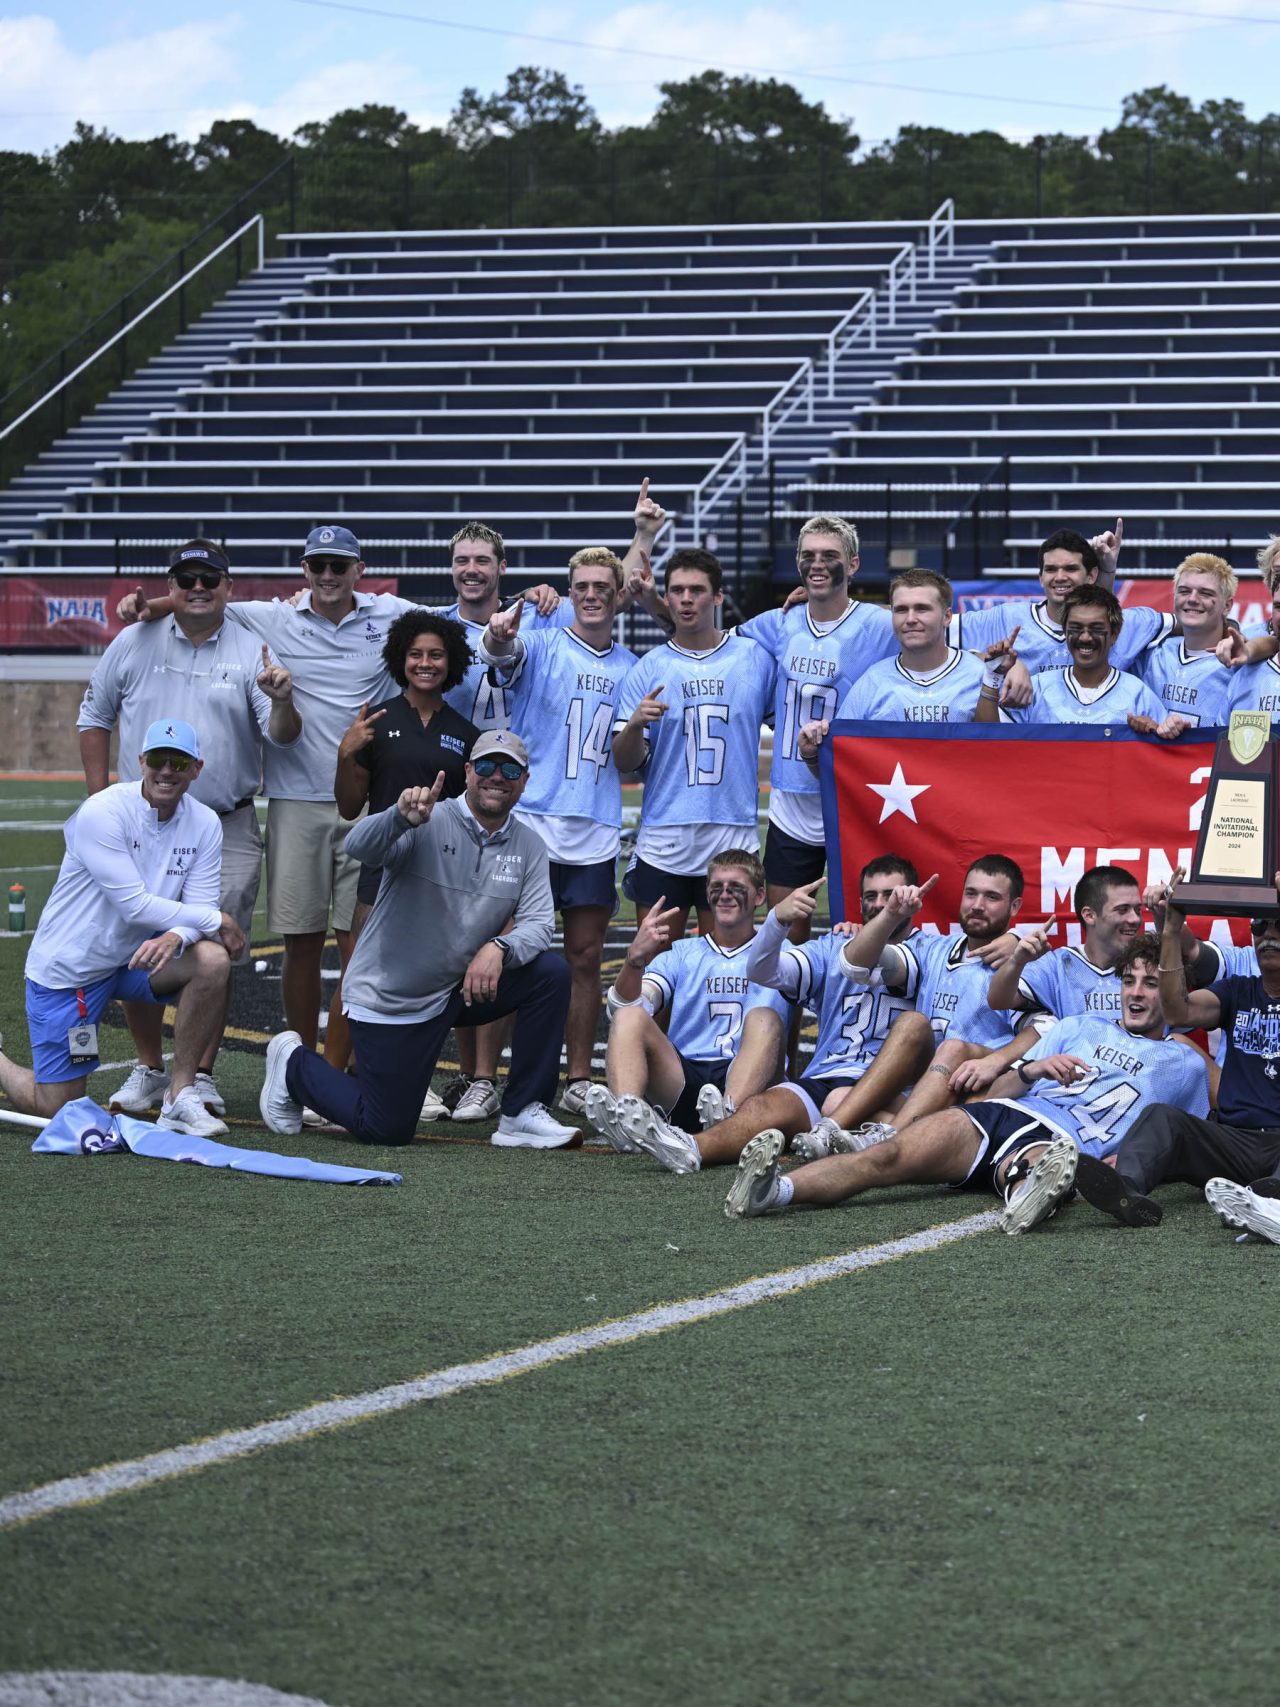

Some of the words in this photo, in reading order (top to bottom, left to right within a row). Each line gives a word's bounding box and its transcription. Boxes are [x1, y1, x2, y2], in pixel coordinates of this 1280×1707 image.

[46, 597, 109, 629] NAIA
[790, 656, 836, 679] KEISER
[576, 673, 615, 696] KEISER
[681, 679, 724, 699] KEISER
[1162, 683, 1198, 706] KEISER
[903, 705, 949, 722] KEISER
[1234, 714, 1267, 730] NAIA
[440, 735, 466, 751] KEISER
[565, 697, 613, 785] 14
[683, 703, 729, 786] 15
[1213, 823, 1259, 832] INVITATIONAL
[1220, 816, 1254, 825] NATIONAL
[1216, 830, 1255, 839] CHAMPION
[173, 847, 197, 855] EISER
[706, 976, 749, 995] KEISER
[1084, 993, 1122, 1012] KEISE
[1235, 1013, 1249, 1027] 20
[1093, 1045, 1144, 1077] KEISER
